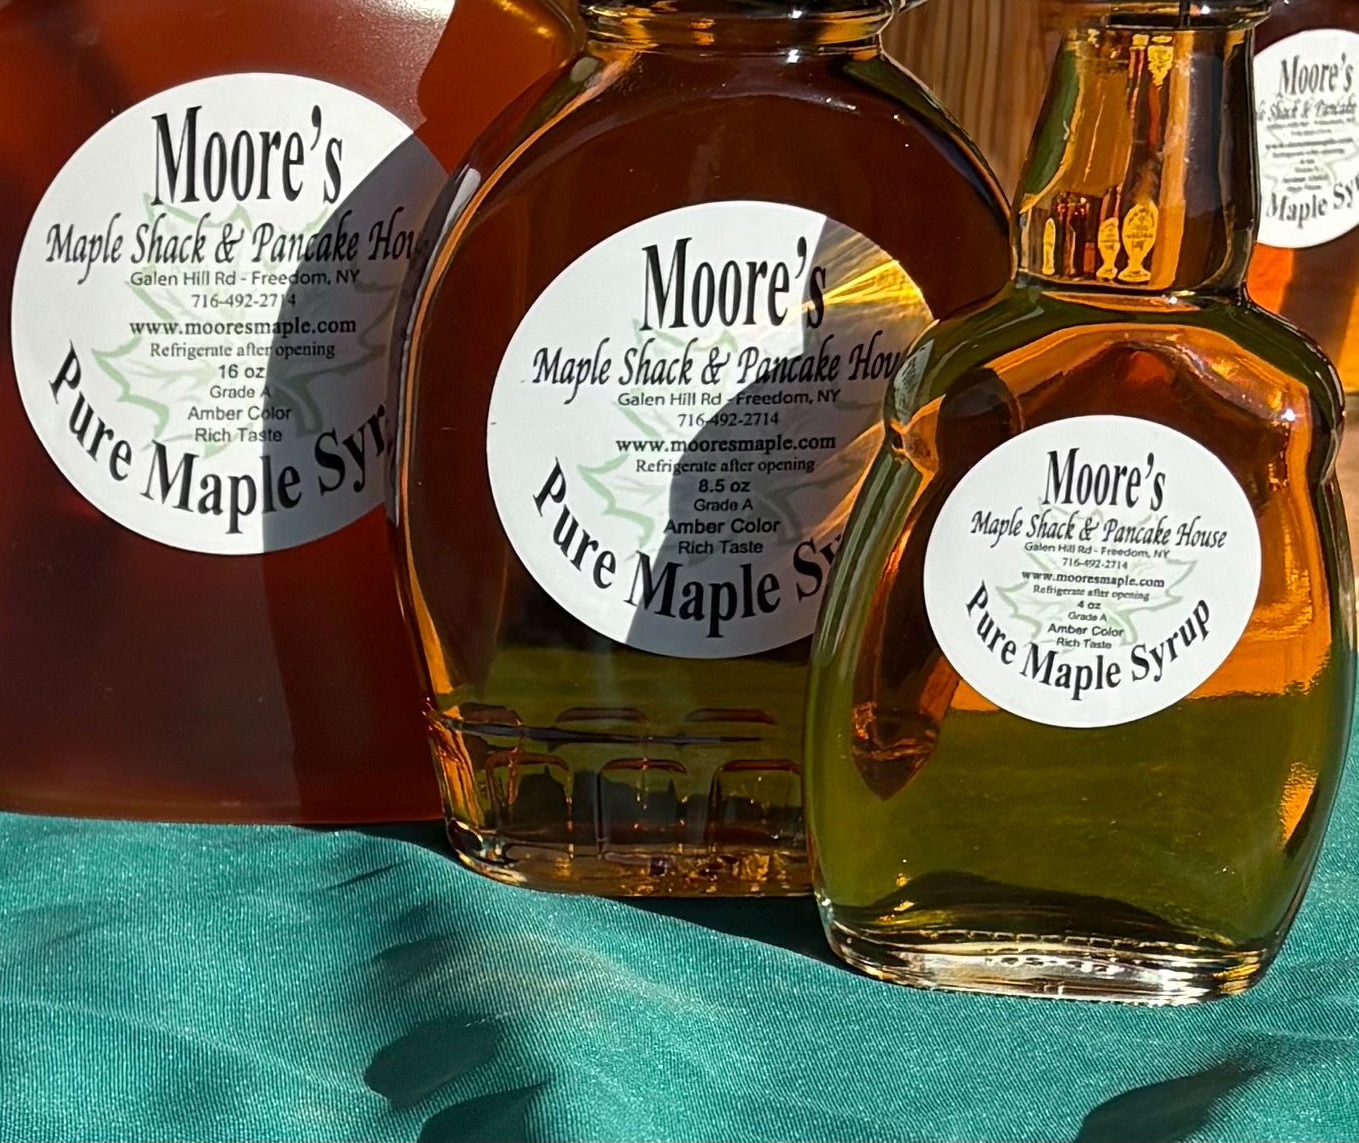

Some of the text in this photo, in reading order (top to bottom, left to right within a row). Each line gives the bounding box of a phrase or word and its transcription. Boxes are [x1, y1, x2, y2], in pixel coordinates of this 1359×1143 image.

[1276, 52, 1354, 98] Moore's
[150, 103, 343, 207] Moore's
[1266, 192, 1328, 229] Maple
[46, 206, 360, 285] Maple Shack & Pancake
[130, 268, 361, 288] Galen Hill Rd Freedom, NY
[640, 235, 826, 331] Moore's
[191, 292, 297, 309] 716-492-2714
[129, 317, 357, 338] www.mooresmaple.com
[150, 341, 336, 360] Refrigerate after opening
[217, 364, 265, 381] 16 oz
[532, 337, 611, 405] Maple
[618, 336, 698, 386] Shack
[701, 346, 732, 385] &
[737, 333, 840, 384] Pancake
[209, 384, 272, 401] Grade A
[617, 388, 841, 408] Galen Hill Rd Freedom, NY
[187, 405, 292, 423] Amber Color
[677, 412, 780, 429] 716-492-2714
[48, 340, 133, 483] Pure
[140, 440, 302, 535] Maple
[194, 427, 283, 444] Rich Taste
[615, 434, 836, 455] www.mooresmaple.com
[635, 456, 815, 477] Refrigerate after opening
[698, 479, 750, 494] 8.5 oz
[1042, 447, 1167, 512] Moore's
[693, 498, 754, 513] Grade A
[663, 518, 781, 536] Amber Color
[971, 506, 1228, 549] Maple Shack & Pancake House
[532, 457, 781, 638] Pure Maple
[678, 539, 763, 555] Rich Taste
[1024, 541, 1056, 553] Galen
[1058, 543, 1076, 554] Hill
[1077, 544, 1092, 555] Rd
[1021, 569, 1165, 589] www.mooresmaple.com
[1033, 584, 1085, 600] Refrigerate
[1111, 589, 1151, 603] opening
[1067, 611, 1098, 623] Grade
[964, 580, 1211, 701] Pure Maple Syrup
[1047, 623, 1125, 638] Amber Color
[1056, 637, 1112, 650] Rich Taste
